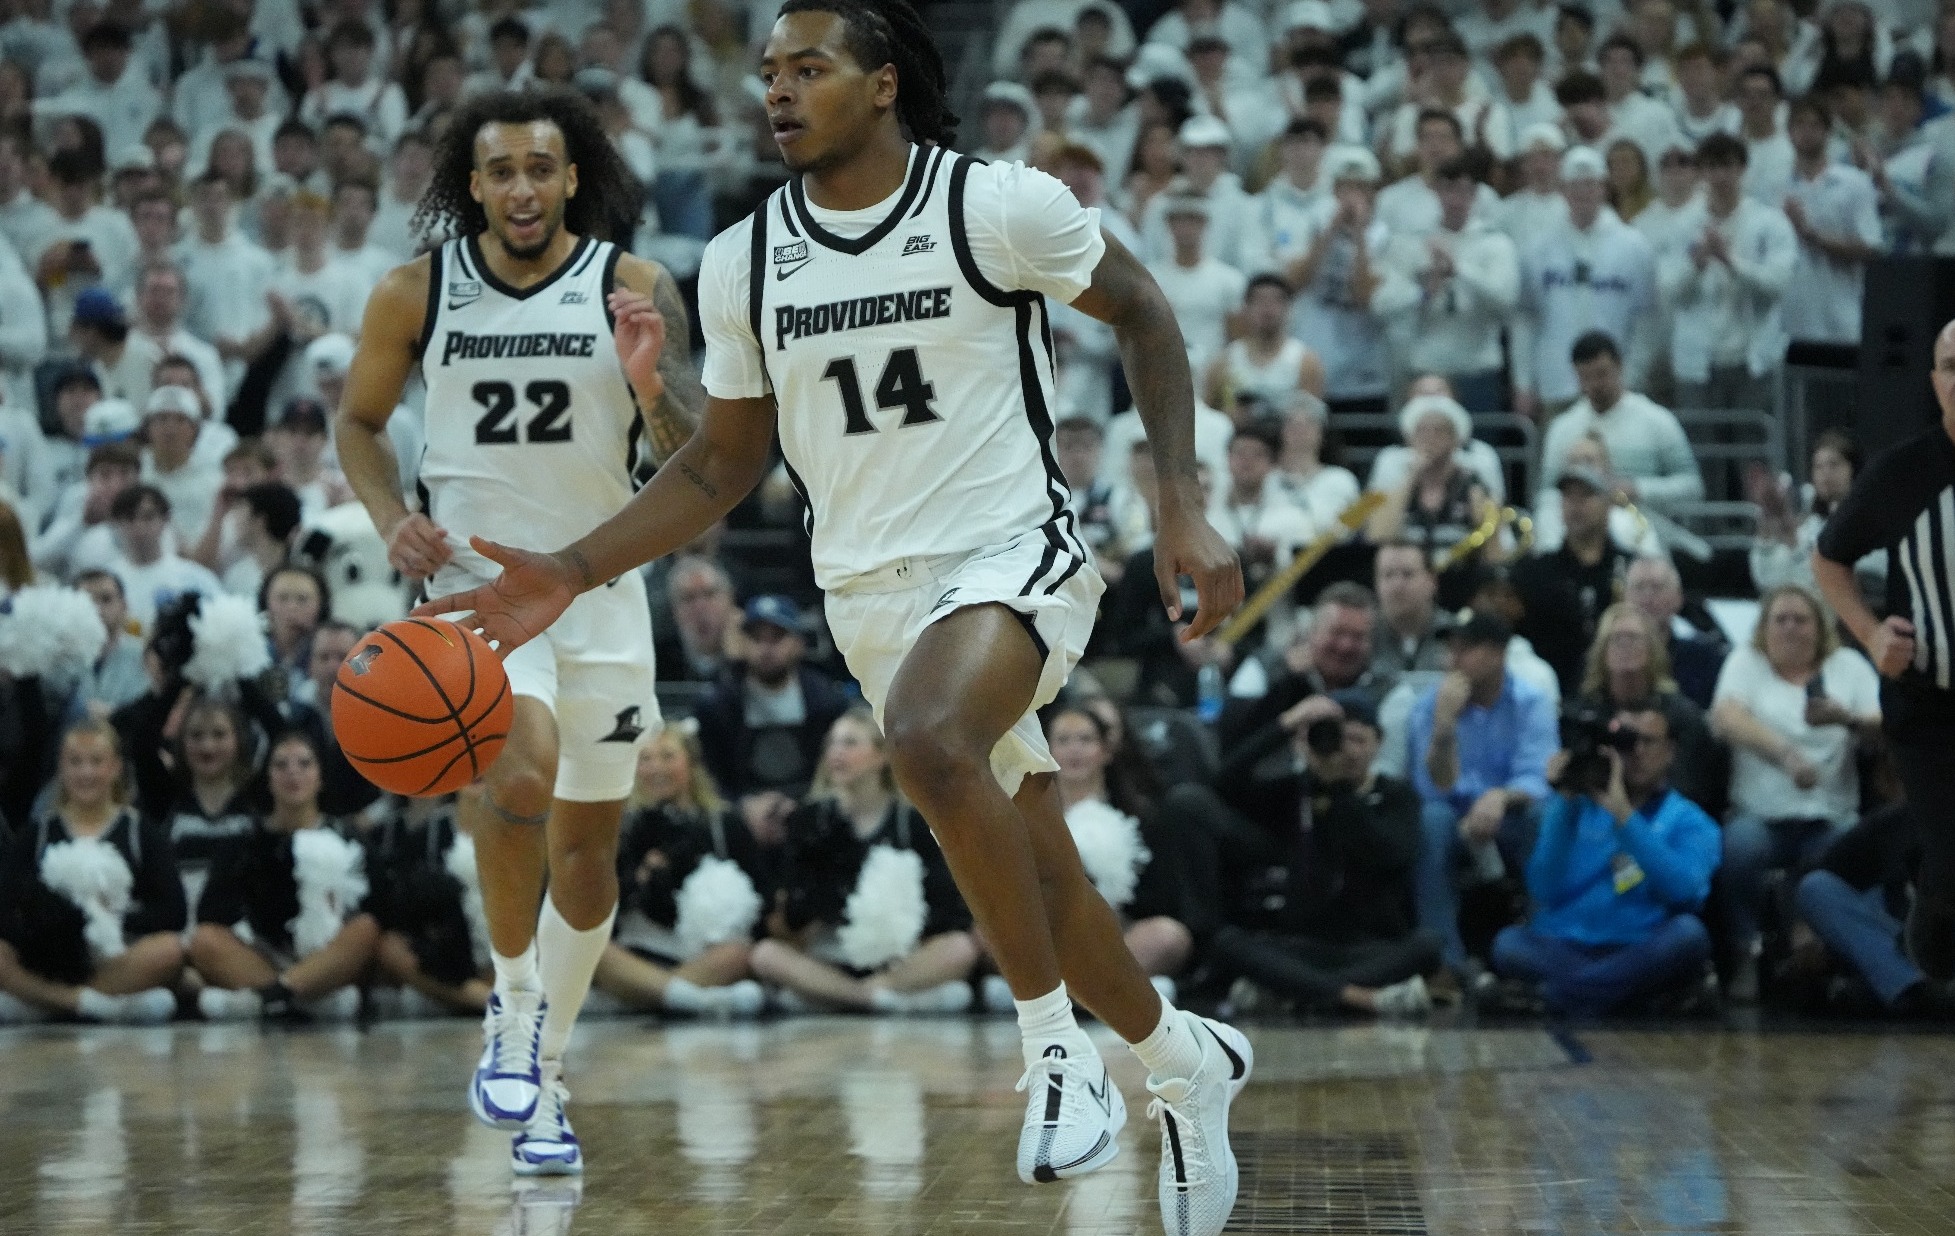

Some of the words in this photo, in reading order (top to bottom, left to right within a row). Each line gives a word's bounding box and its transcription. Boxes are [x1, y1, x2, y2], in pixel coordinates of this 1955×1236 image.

[903, 242, 938, 252] EAST
[906, 234, 931, 245] BIG
[774, 286, 953, 351] PROVIDENCE
[441, 330, 597, 367] PROVIDENCE
[471, 378, 574, 446] 22
[819, 345, 946, 437] 14
